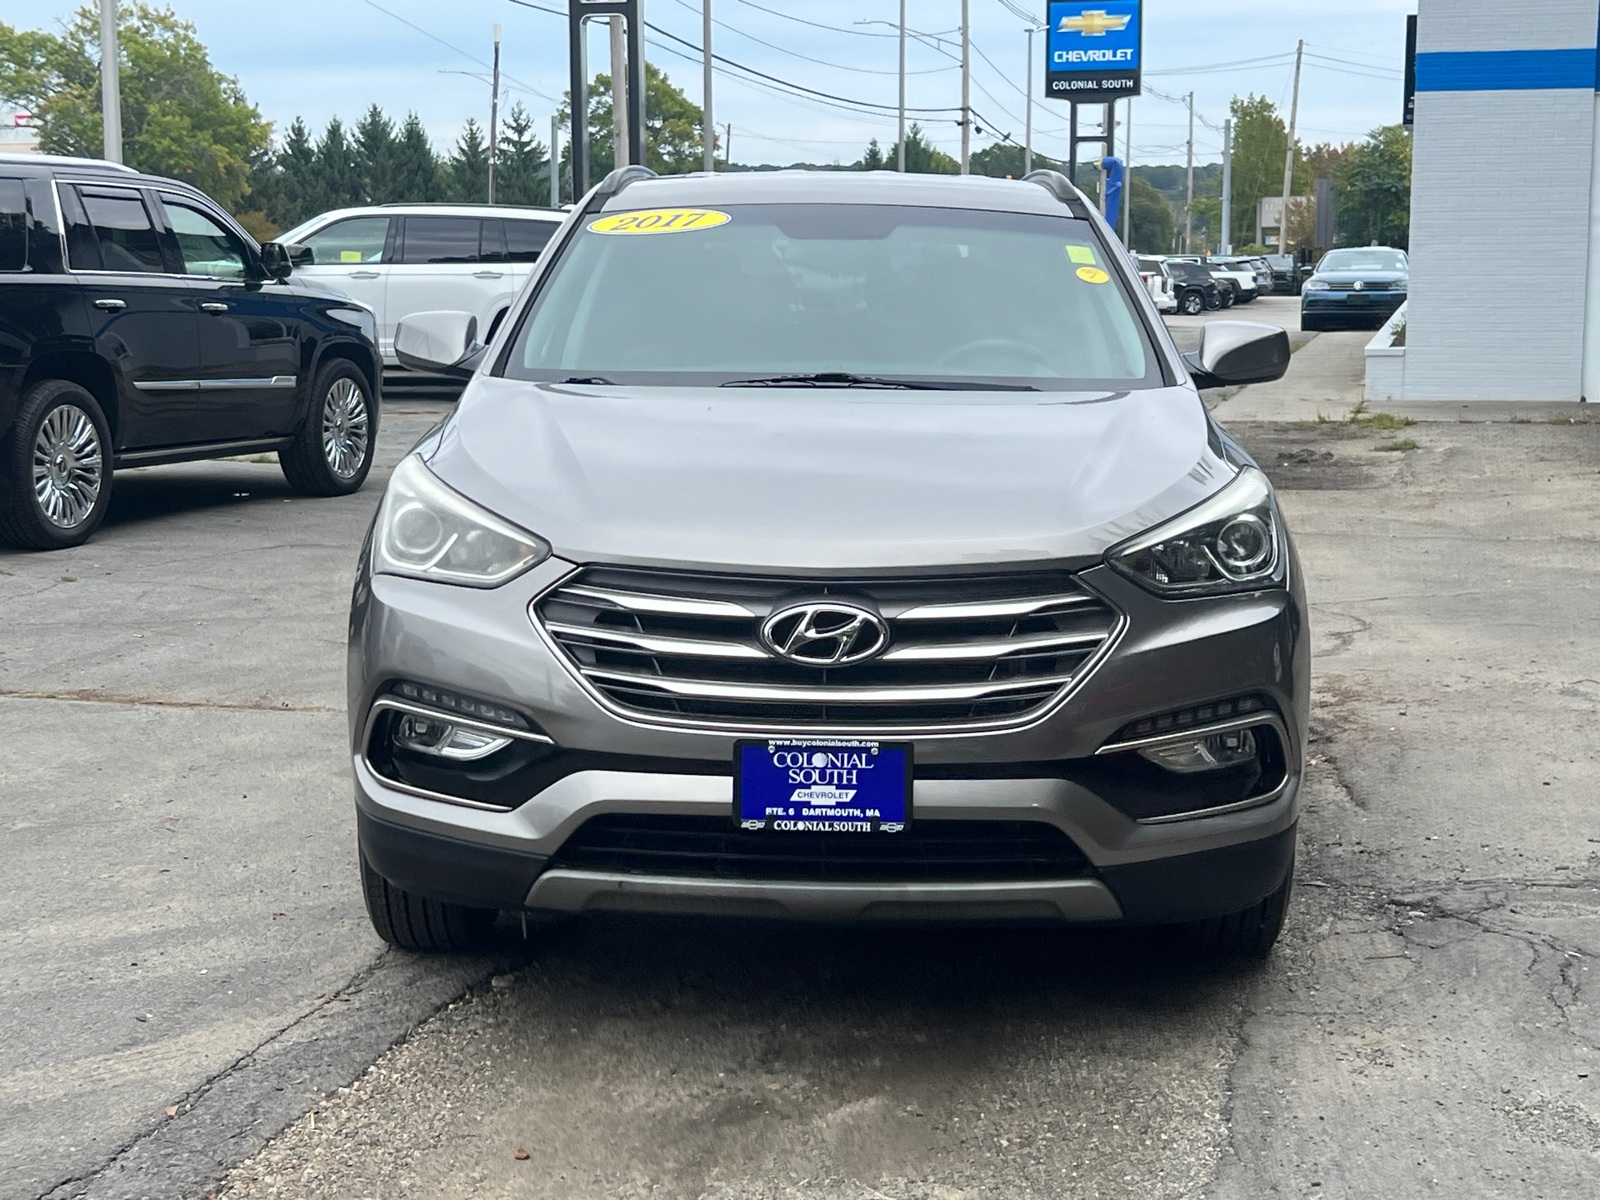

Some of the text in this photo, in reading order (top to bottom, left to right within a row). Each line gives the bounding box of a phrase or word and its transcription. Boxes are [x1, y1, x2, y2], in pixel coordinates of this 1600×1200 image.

[1054, 49, 1134, 63] CHEVROLET
[1052, 80, 1133, 90] COLONIAL SOUTH
[609, 213, 707, 231] 2017
[768, 739, 879, 748] www.buycolonialsouth.com
[773, 752, 874, 769] COLONIAL
[788, 769, 858, 785] SOUTH
[797, 791, 850, 799] CHEVROLET
[765, 807, 880, 818] RTE. 6 DARTMOUTH, MA
[773, 820, 871, 832] COLONIAL SOUTH
